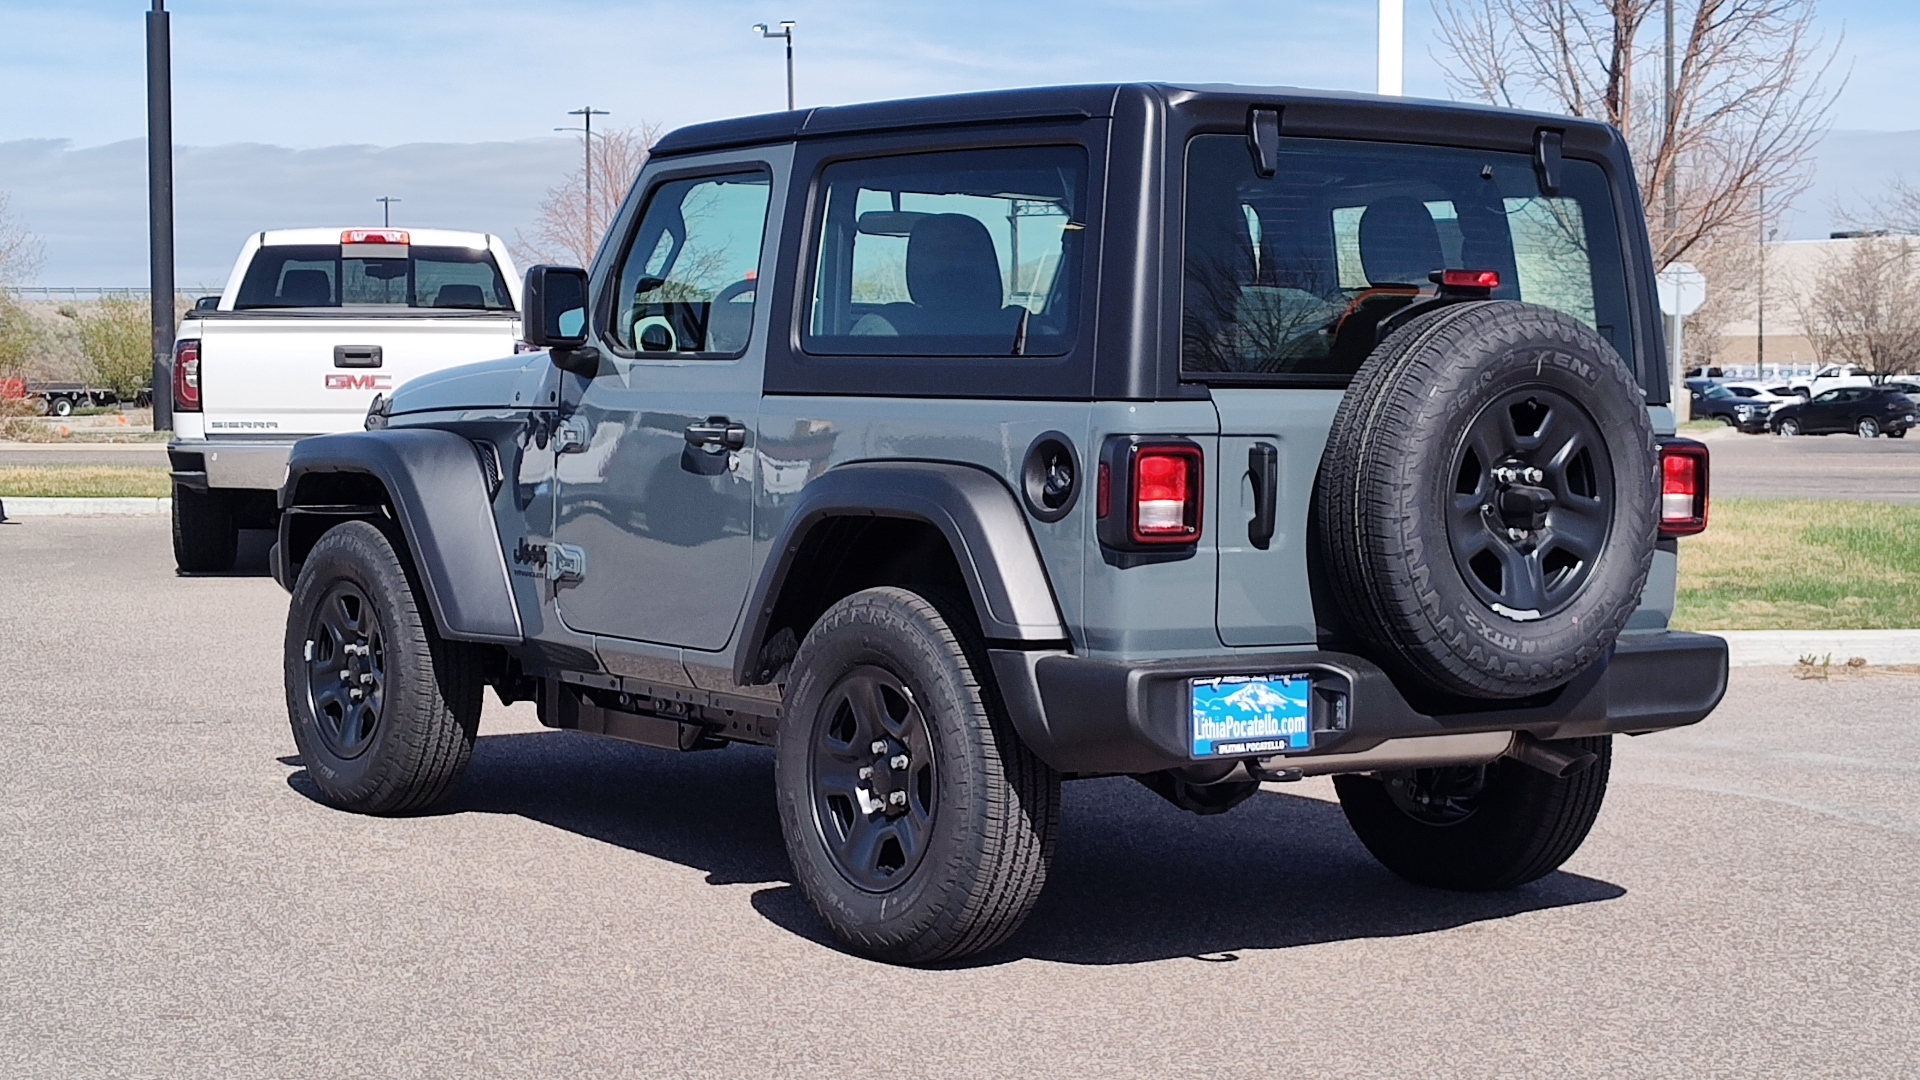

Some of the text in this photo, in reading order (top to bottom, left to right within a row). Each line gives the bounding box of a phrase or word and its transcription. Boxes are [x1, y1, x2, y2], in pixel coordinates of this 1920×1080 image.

[325, 374, 392, 390] GMC
[211, 421, 278, 429] SIERRA
[513, 536, 547, 570] Jeep
[1194, 713, 1306, 740] LithiaPocatello.com
[1246, 740, 1285, 752] POCATELLO
